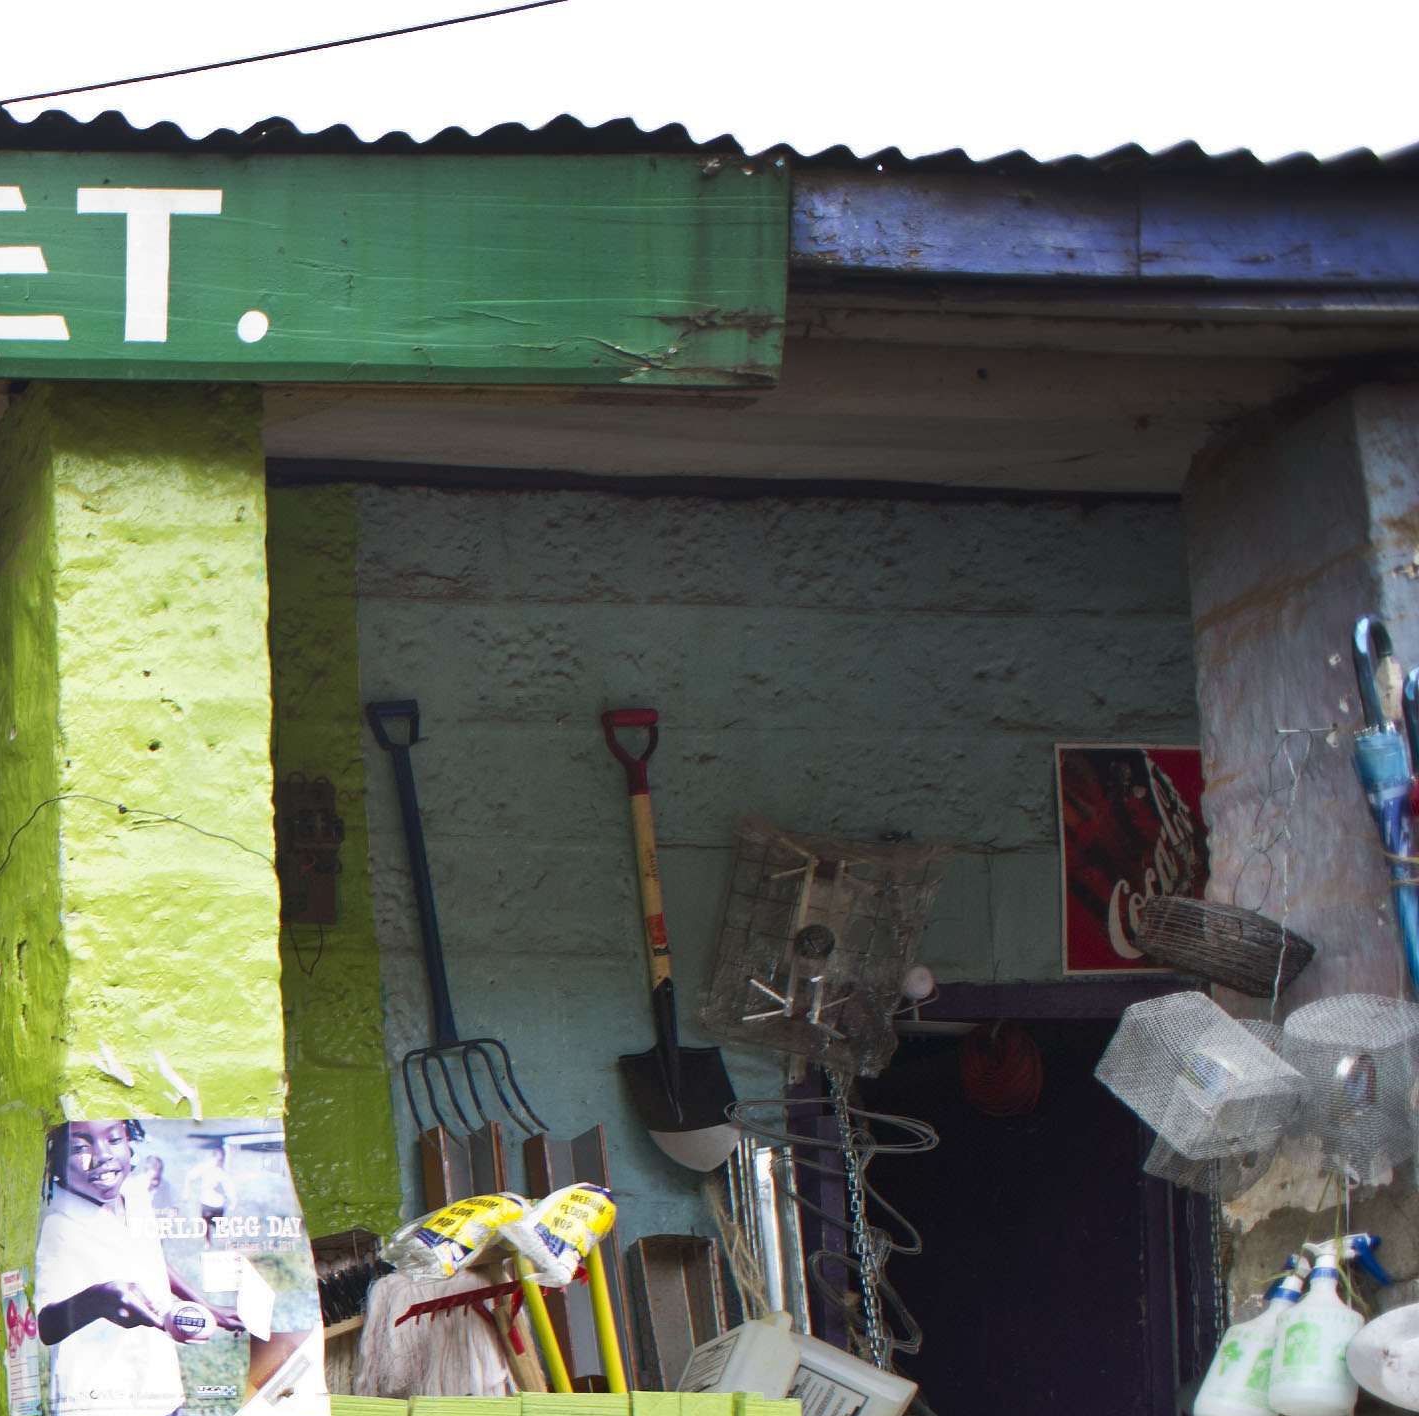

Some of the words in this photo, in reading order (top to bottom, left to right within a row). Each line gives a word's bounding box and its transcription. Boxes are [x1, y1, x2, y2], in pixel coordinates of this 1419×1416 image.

[130, 1217, 208, 1239] WORLD
[211, 1216, 261, 1239] EGG
[266, 1216, 302, 1238] DAY
